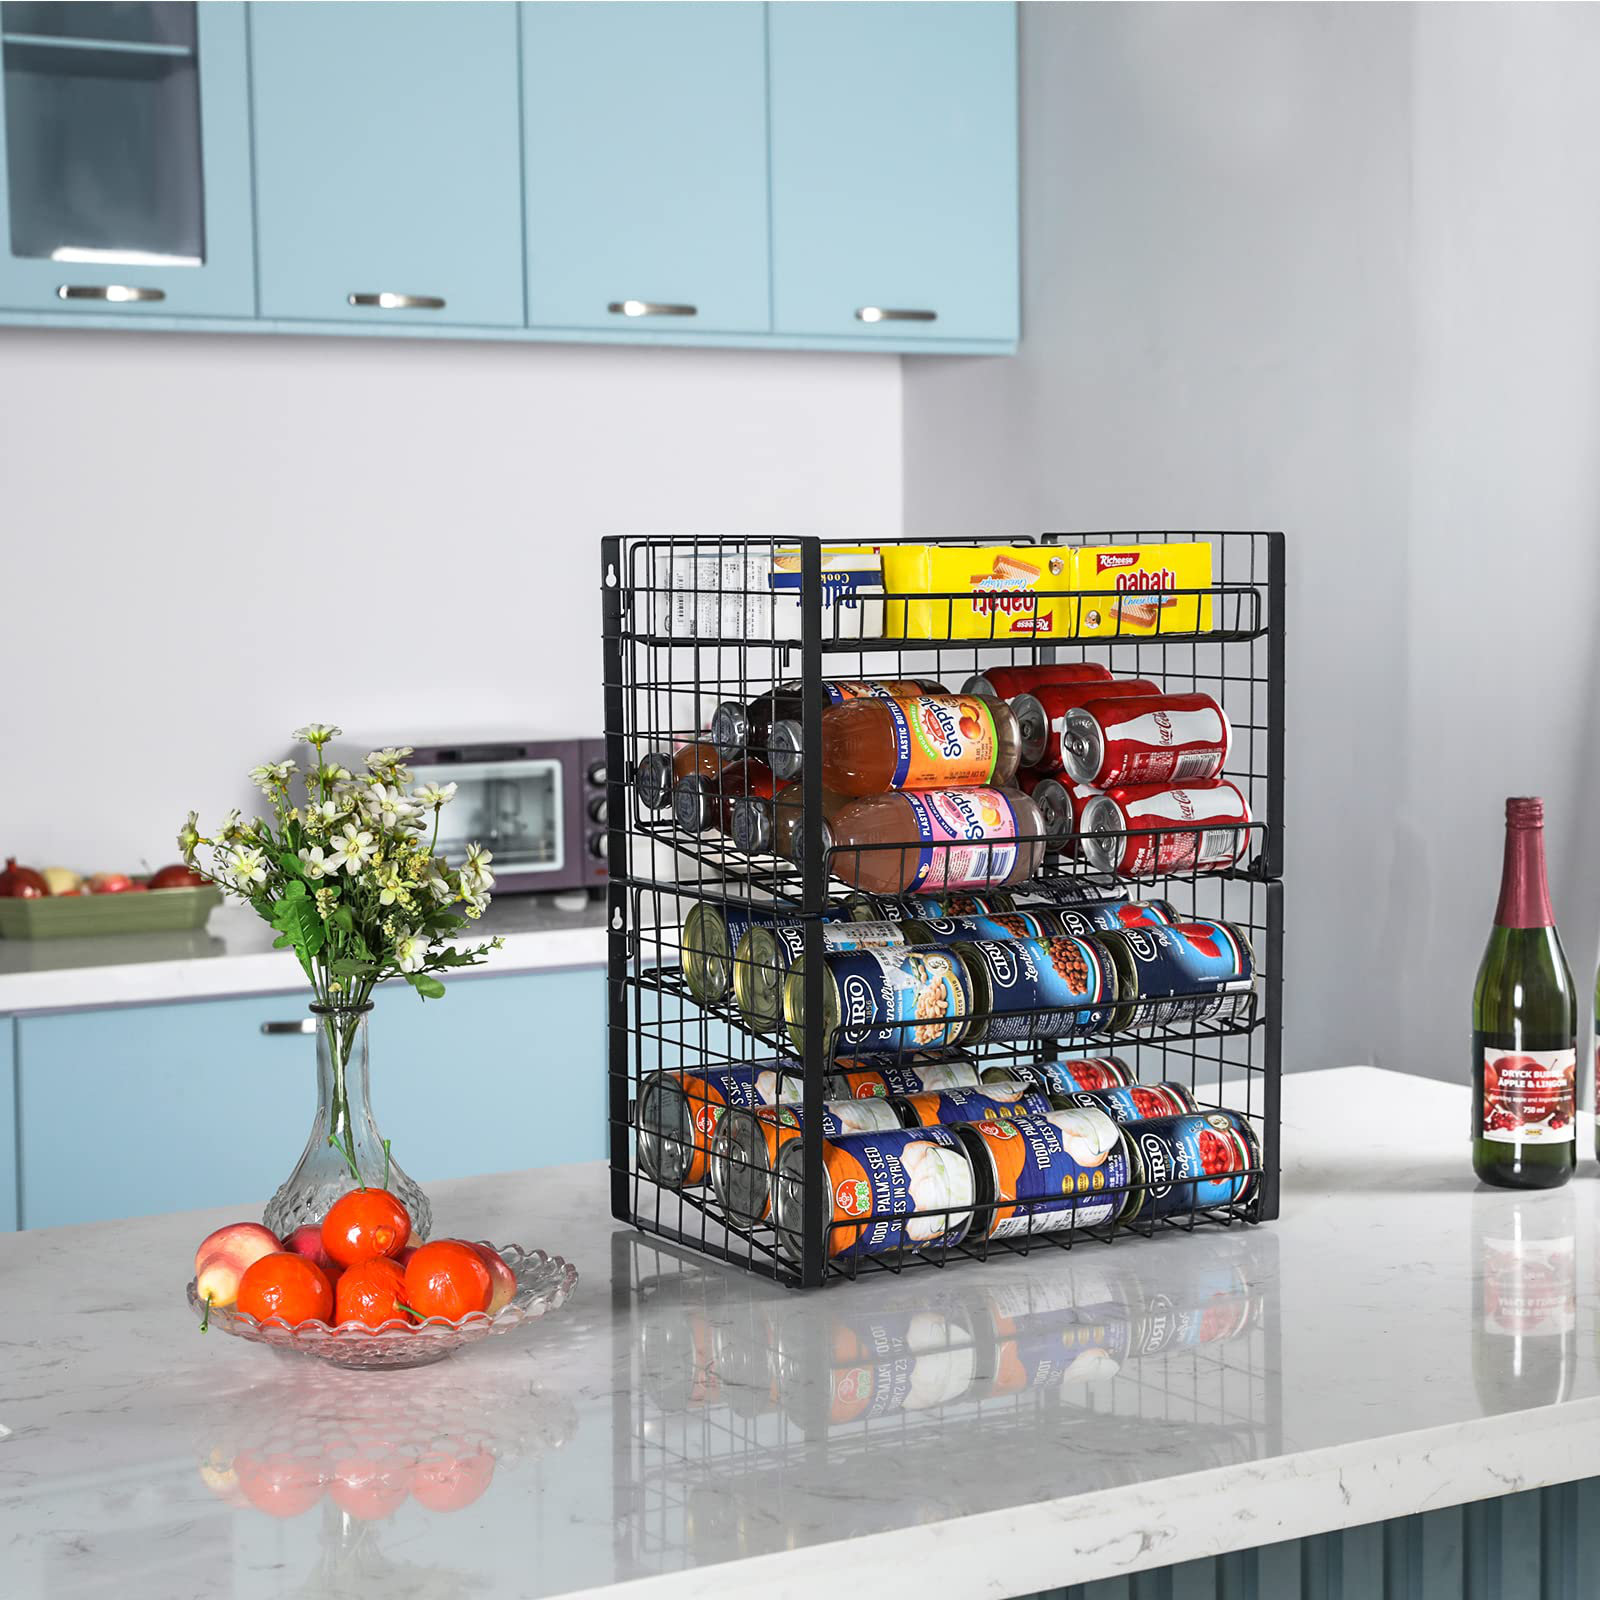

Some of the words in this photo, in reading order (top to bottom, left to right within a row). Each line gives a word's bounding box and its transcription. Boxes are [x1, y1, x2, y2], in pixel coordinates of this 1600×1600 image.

[1099, 554, 1134, 567] Richeese
[1116, 568, 1176, 593] nabati
[1016, 618, 1049, 631] Riceese
[918, 697, 962, 758] Snapple
[899, 727, 909, 760] PLASTIC
[919, 734, 935, 757] MANGO
[915, 806, 930, 836] PLASTIC
[935, 791, 984, 840] Snapp
[1065, 914, 1085, 936] RIO
[782, 927, 804, 959] IRIO
[1125, 929, 1151, 956] CIR
[980, 940, 1011, 980] CIRIO
[864, 999, 873, 1019] 1856
[953, 999, 964, 1035] FRAESCO
[1014, 1065, 1039, 1085] RIO
[1043, 1064, 1066, 1093] Polpa
[1501, 1069, 1532, 1079] DRYCK
[1527, 1080, 1535, 1088] &
[741, 1082, 760, 1107] YRUP
[822, 1116, 837, 1135] ICES
[1013, 1118, 1038, 1136] PALM
[1040, 1126, 1062, 1154] SLICES
[864, 1145, 885, 1170] SEED
[1031, 1138, 1052, 1170] TODDY
[1146, 1139, 1167, 1192] CIRIO
[1175, 1140, 1191, 1180] Polpa
[885, 1154, 905, 1185] SYRUP
[874, 1172, 892, 1212] PALM'S
[894, 1187, 906, 1198] IN
[869, 1220, 889, 1245] TODD
